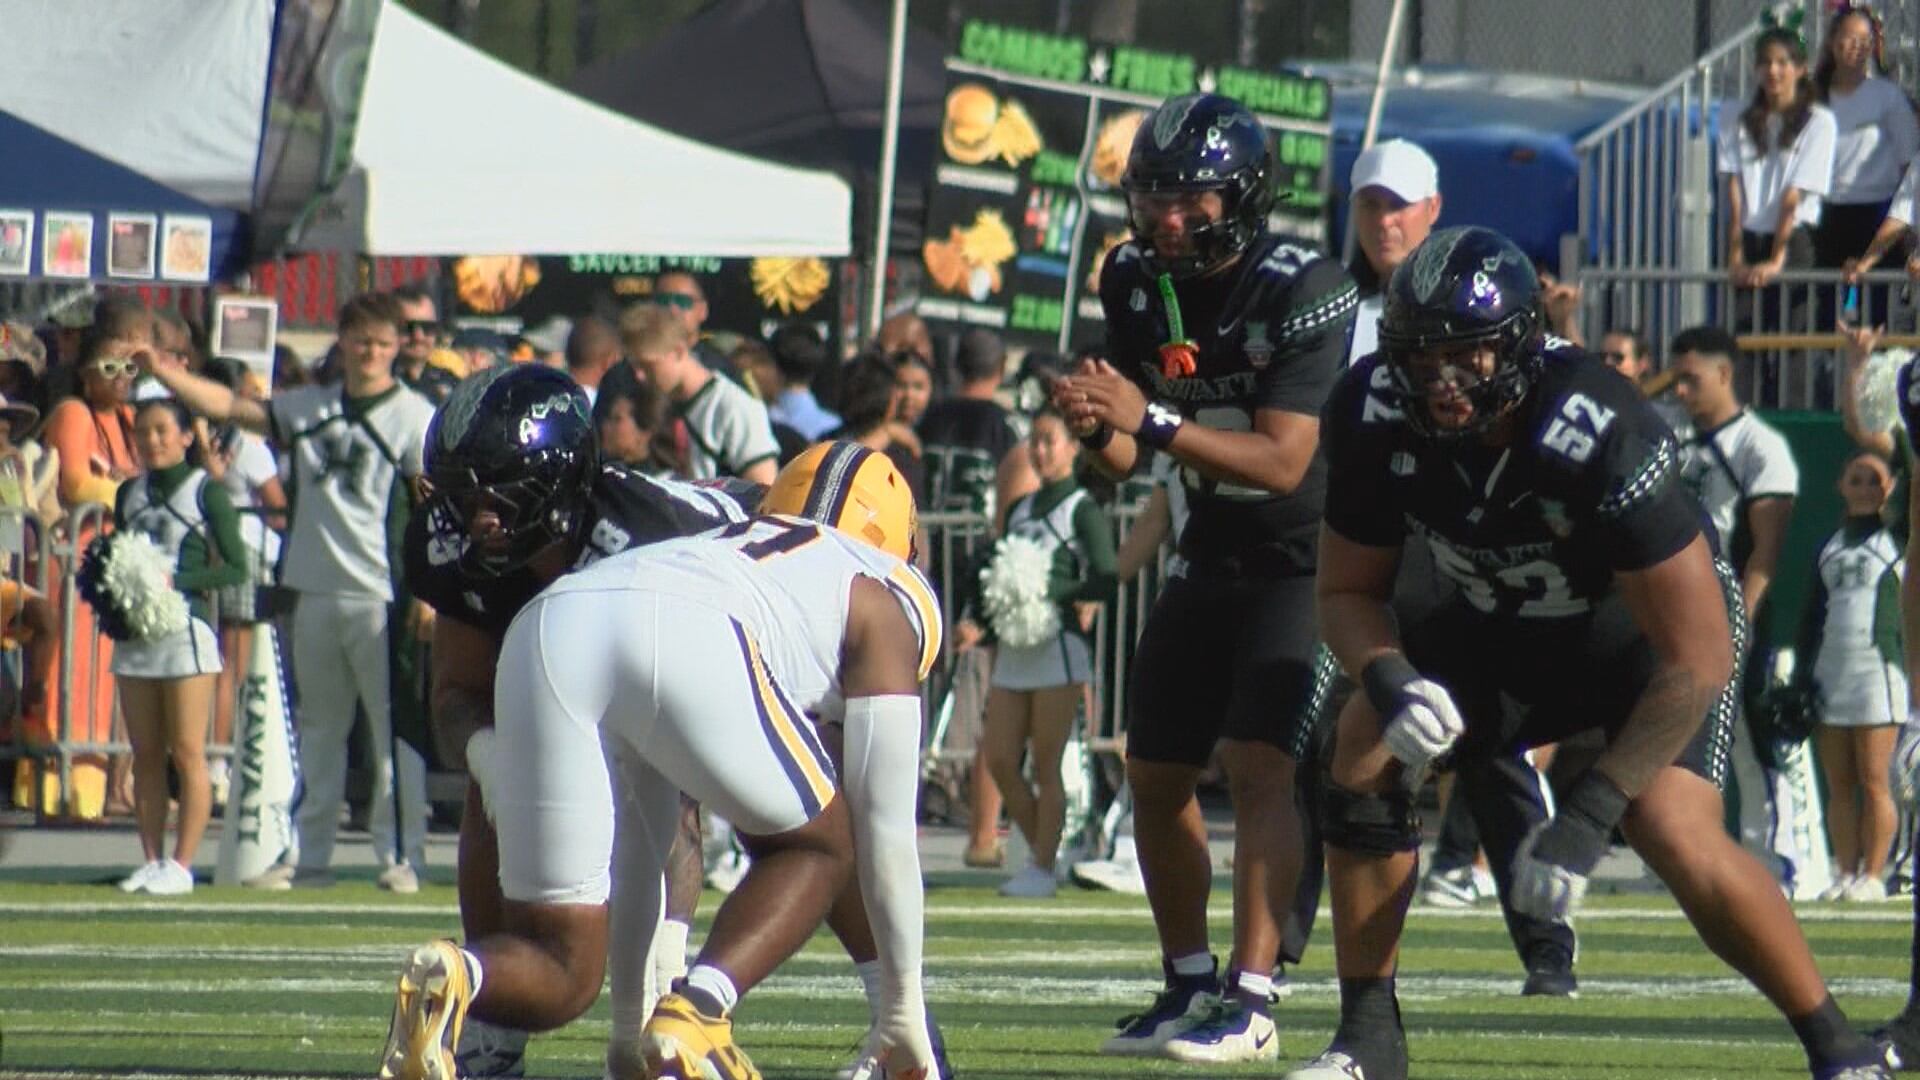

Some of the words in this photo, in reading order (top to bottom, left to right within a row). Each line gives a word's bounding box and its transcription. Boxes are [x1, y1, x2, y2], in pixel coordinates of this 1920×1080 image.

[962, 18, 1086, 84] COMBOS
[1111, 46, 1197, 98] FRIES
[1220, 68, 1327, 119] SPECIALS
[1541, 392, 1617, 462] 52
